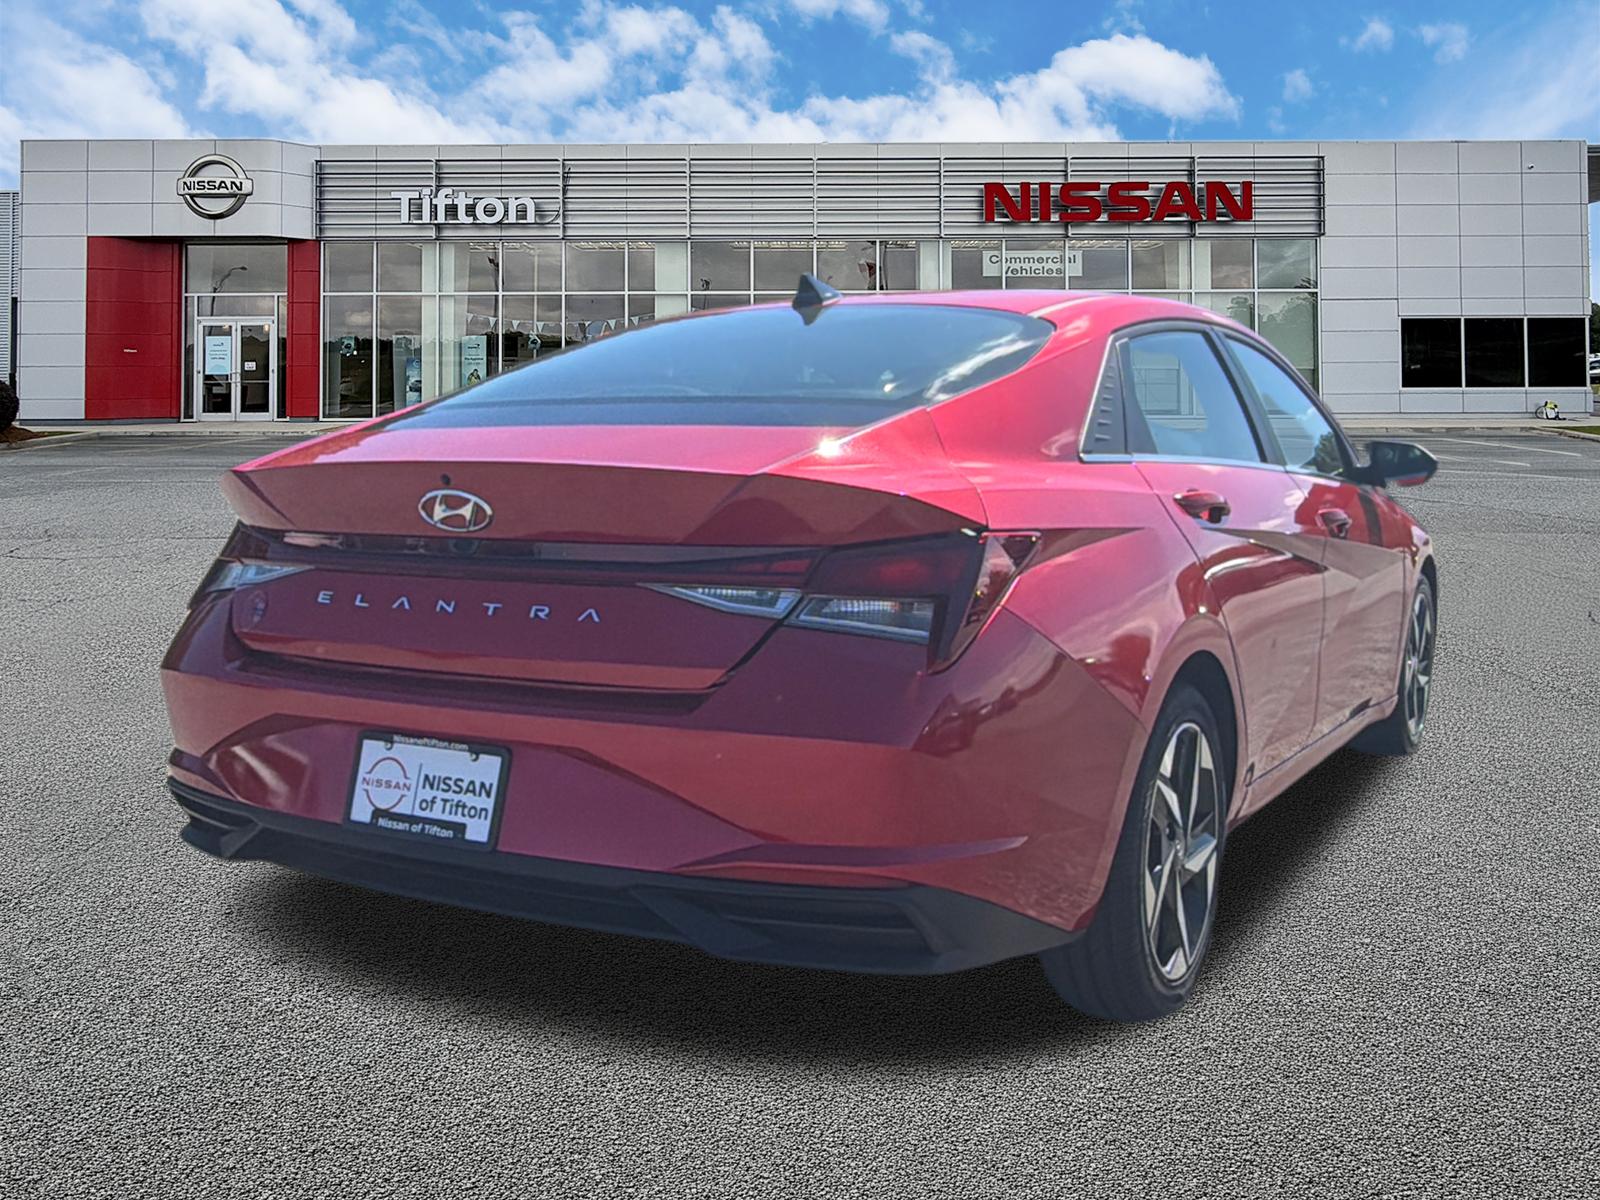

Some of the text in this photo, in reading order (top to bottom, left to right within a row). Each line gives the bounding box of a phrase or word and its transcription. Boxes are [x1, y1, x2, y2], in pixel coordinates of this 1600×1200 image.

[183, 180, 243, 191] NISSAN
[391, 187, 536, 224] Tifton
[983, 180, 1253, 222] NISSAN
[317, 591, 600, 623] ELANTRA
[361, 776, 412, 792] NISSAN
[422, 773, 494, 799] NISSAN
[419, 796, 489, 821] of Tifton
[377, 817, 454, 838] Nissan of Tifton
